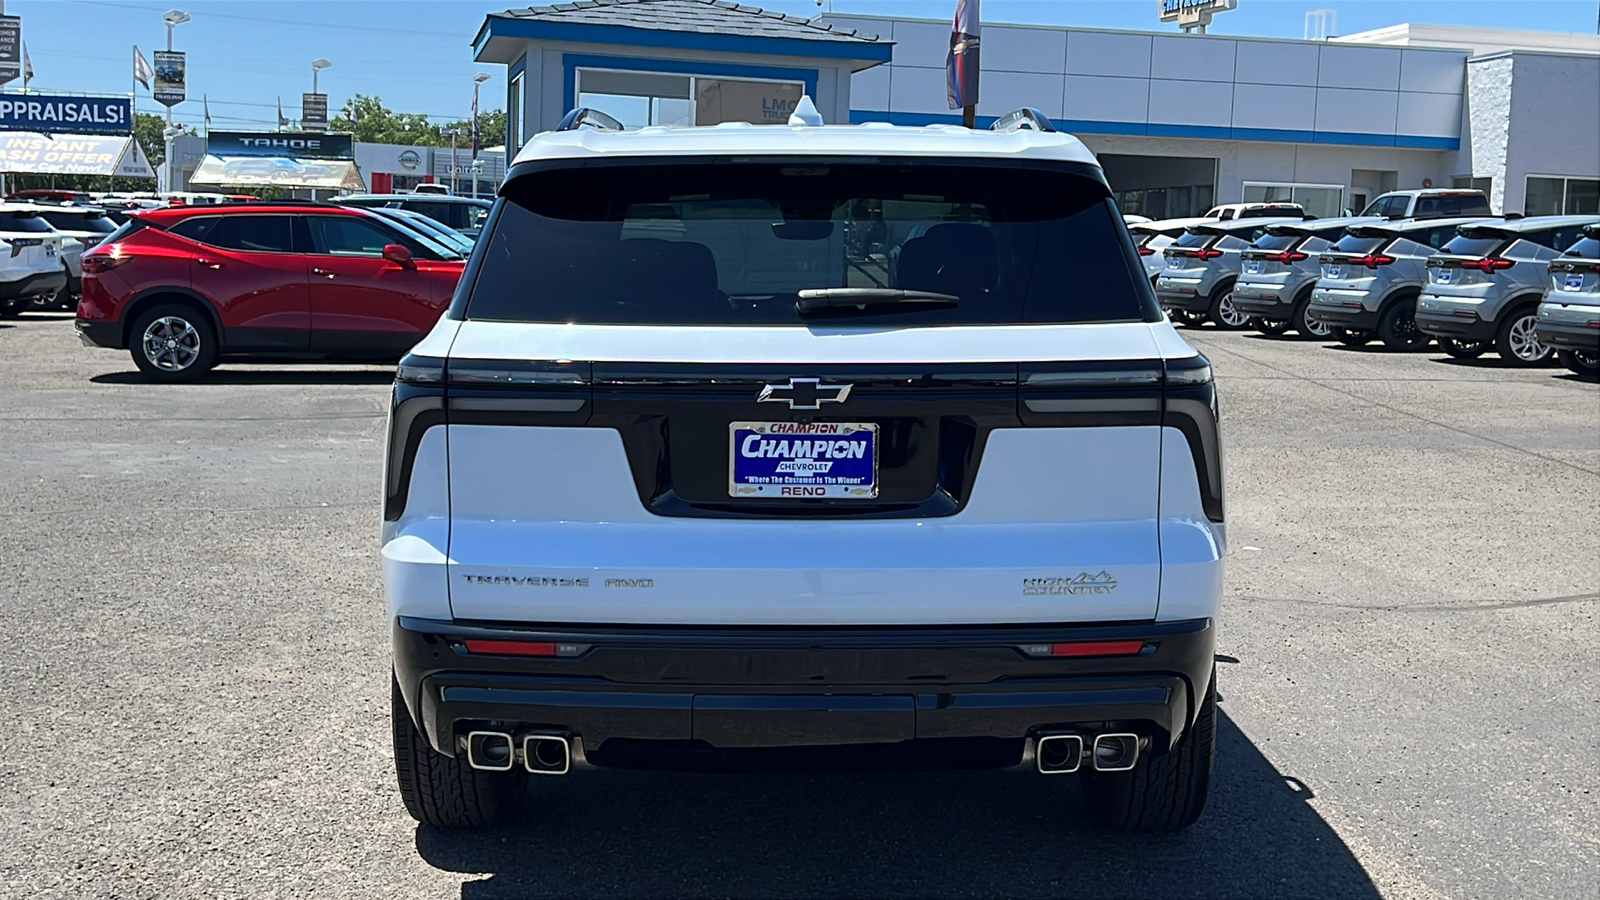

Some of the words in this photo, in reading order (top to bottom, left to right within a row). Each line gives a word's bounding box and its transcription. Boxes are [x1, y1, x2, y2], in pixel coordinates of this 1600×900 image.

[6, 138, 101, 152] INSTANT
[239, 138, 321, 150] TAHOE
[44, 152, 113, 164] OFFER
[769, 423, 839, 434] CHAMPION
[741, 435, 867, 459] CHAMPION
[779, 462, 829, 471] CHEVROLET
[771, 476, 783, 484] The
[784, 476, 816, 484] Customer
[816, 476, 823, 484] Is
[824, 477, 836, 485] The
[781, 486, 826, 496] RENO
[463, 574, 590, 587] TRAVERSE
[604, 578, 654, 588] AWD
[1023, 577, 1072, 586] HIGH
[1023, 585, 1118, 596] COUNTRY
